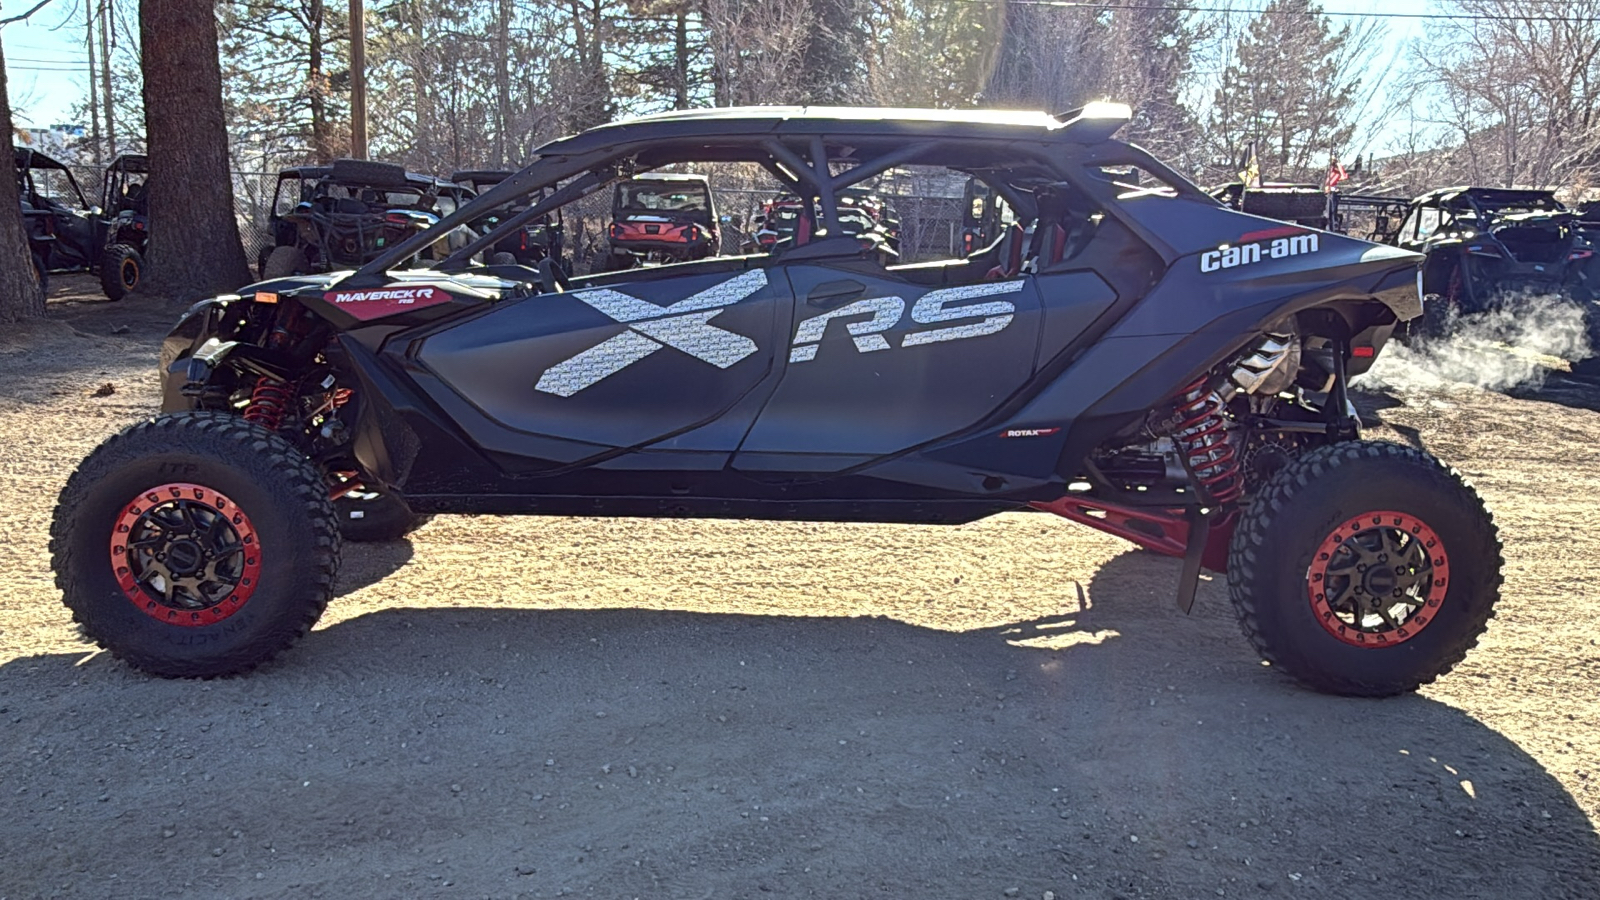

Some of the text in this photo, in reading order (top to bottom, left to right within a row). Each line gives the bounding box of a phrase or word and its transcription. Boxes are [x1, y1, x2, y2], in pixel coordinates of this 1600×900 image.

[1201, 234, 1318, 273] can-am
[335, 288, 434, 302] MAVERICK R
[534, 268, 1025, 397] X RS
